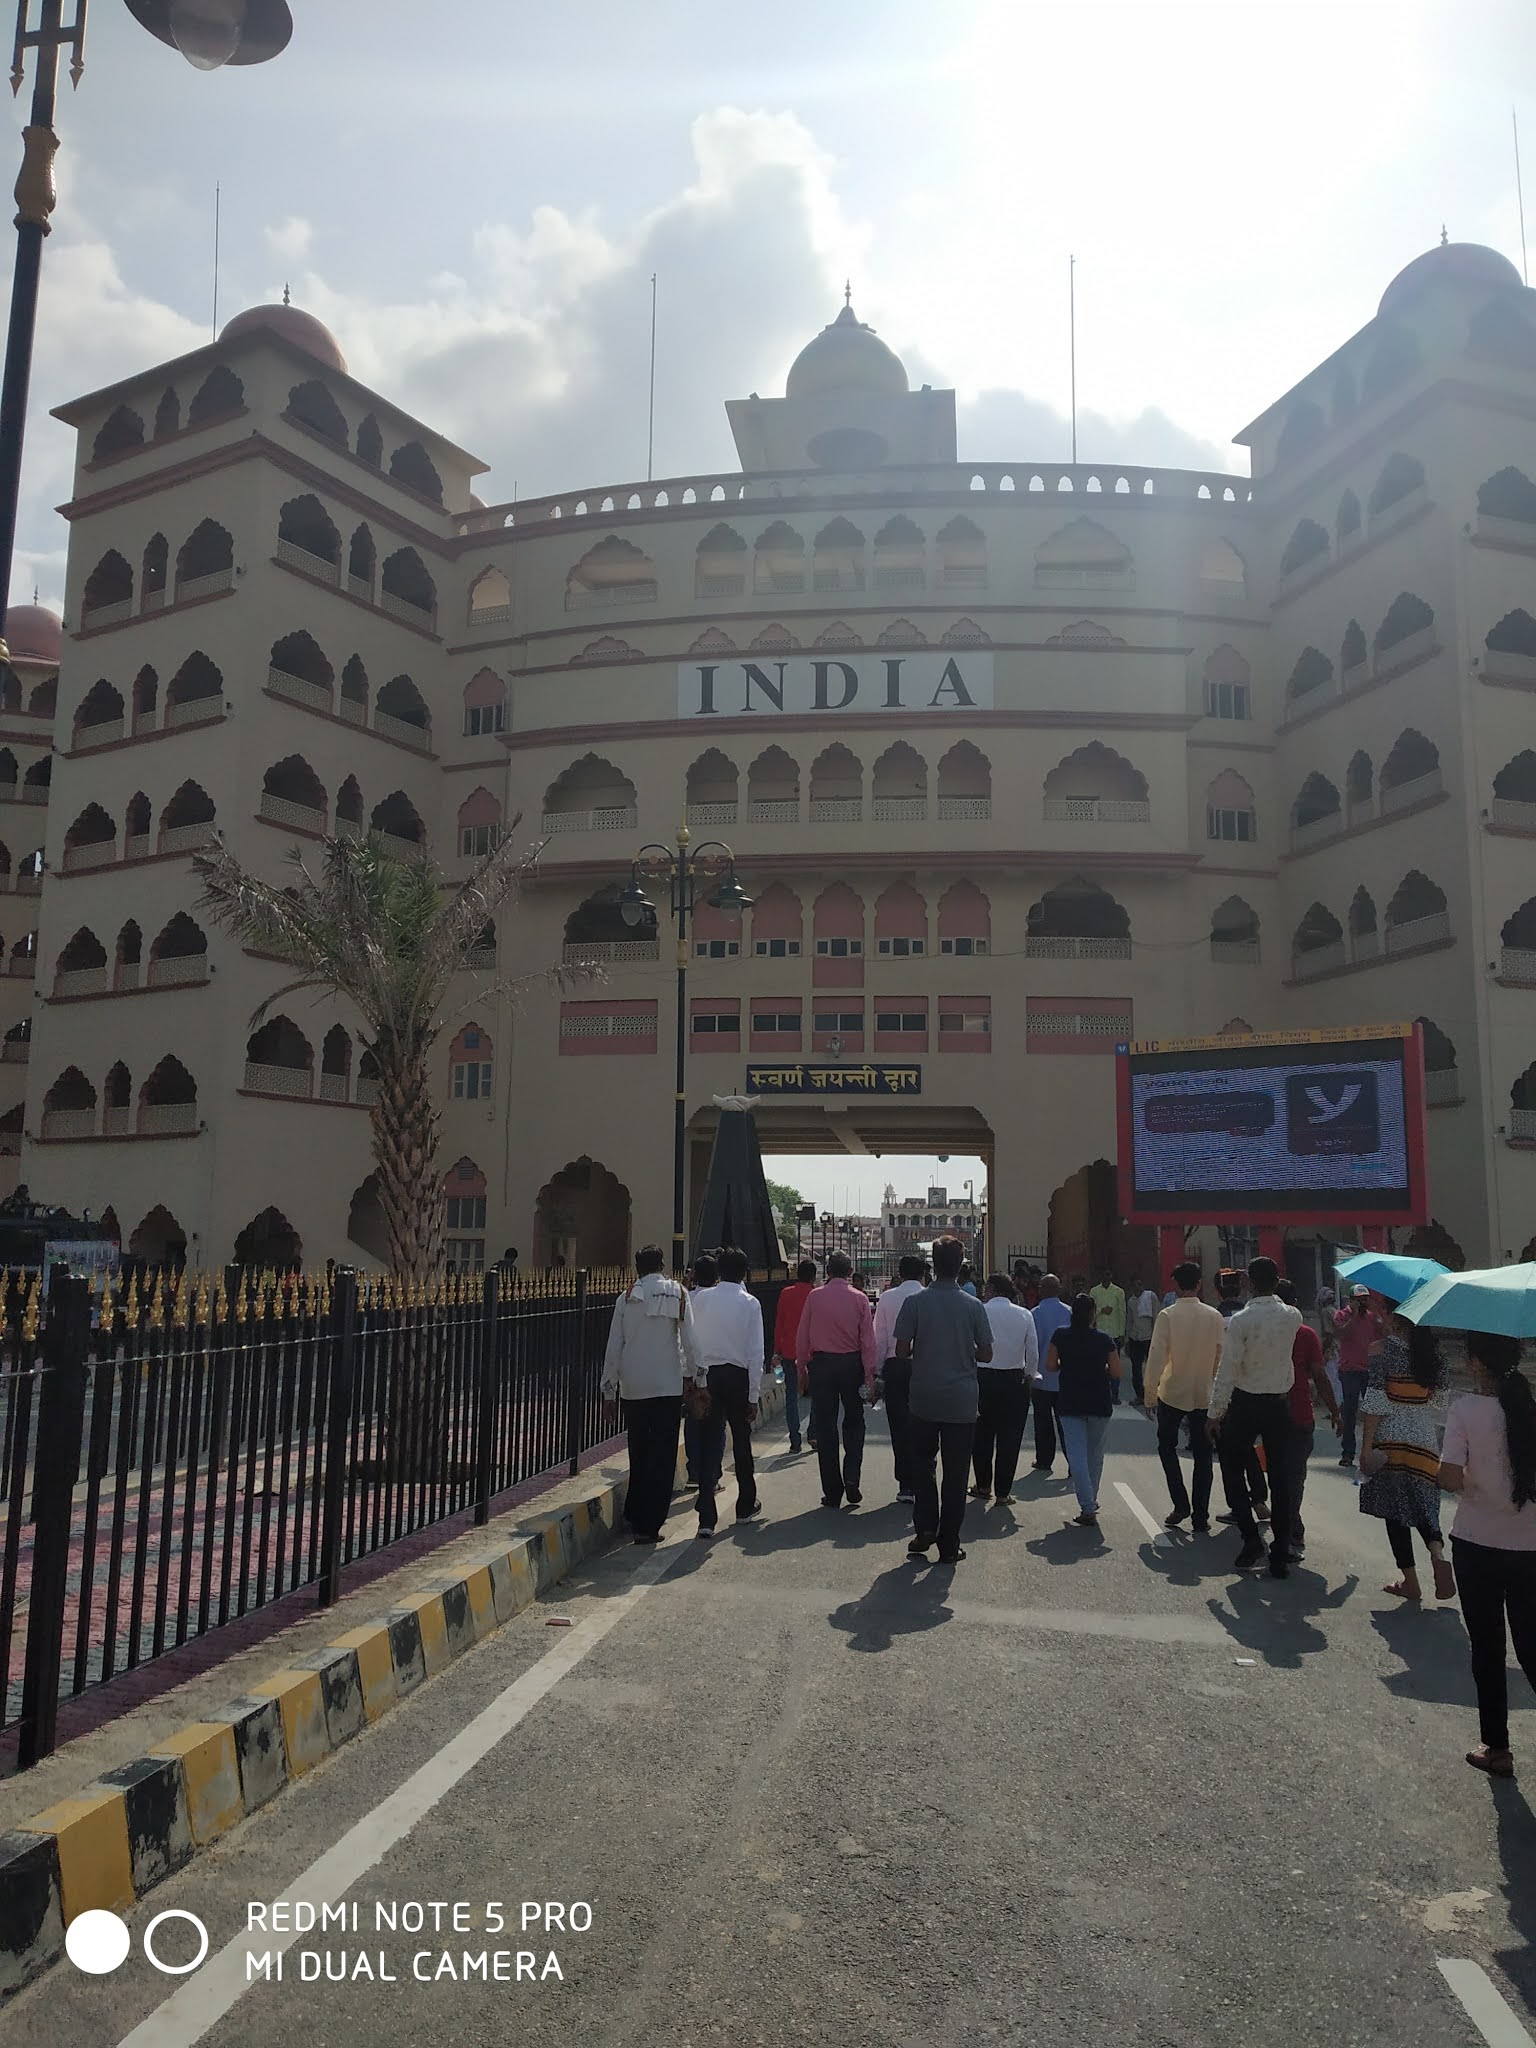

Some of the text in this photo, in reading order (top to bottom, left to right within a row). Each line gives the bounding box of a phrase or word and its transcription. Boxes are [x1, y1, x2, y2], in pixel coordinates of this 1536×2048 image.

[695, 656, 978, 715] INDIA
[1135, 1040, 1160, 1053] LIC
[750, 1065, 918, 1092] स्वर्ण जयन्ती द्वार
